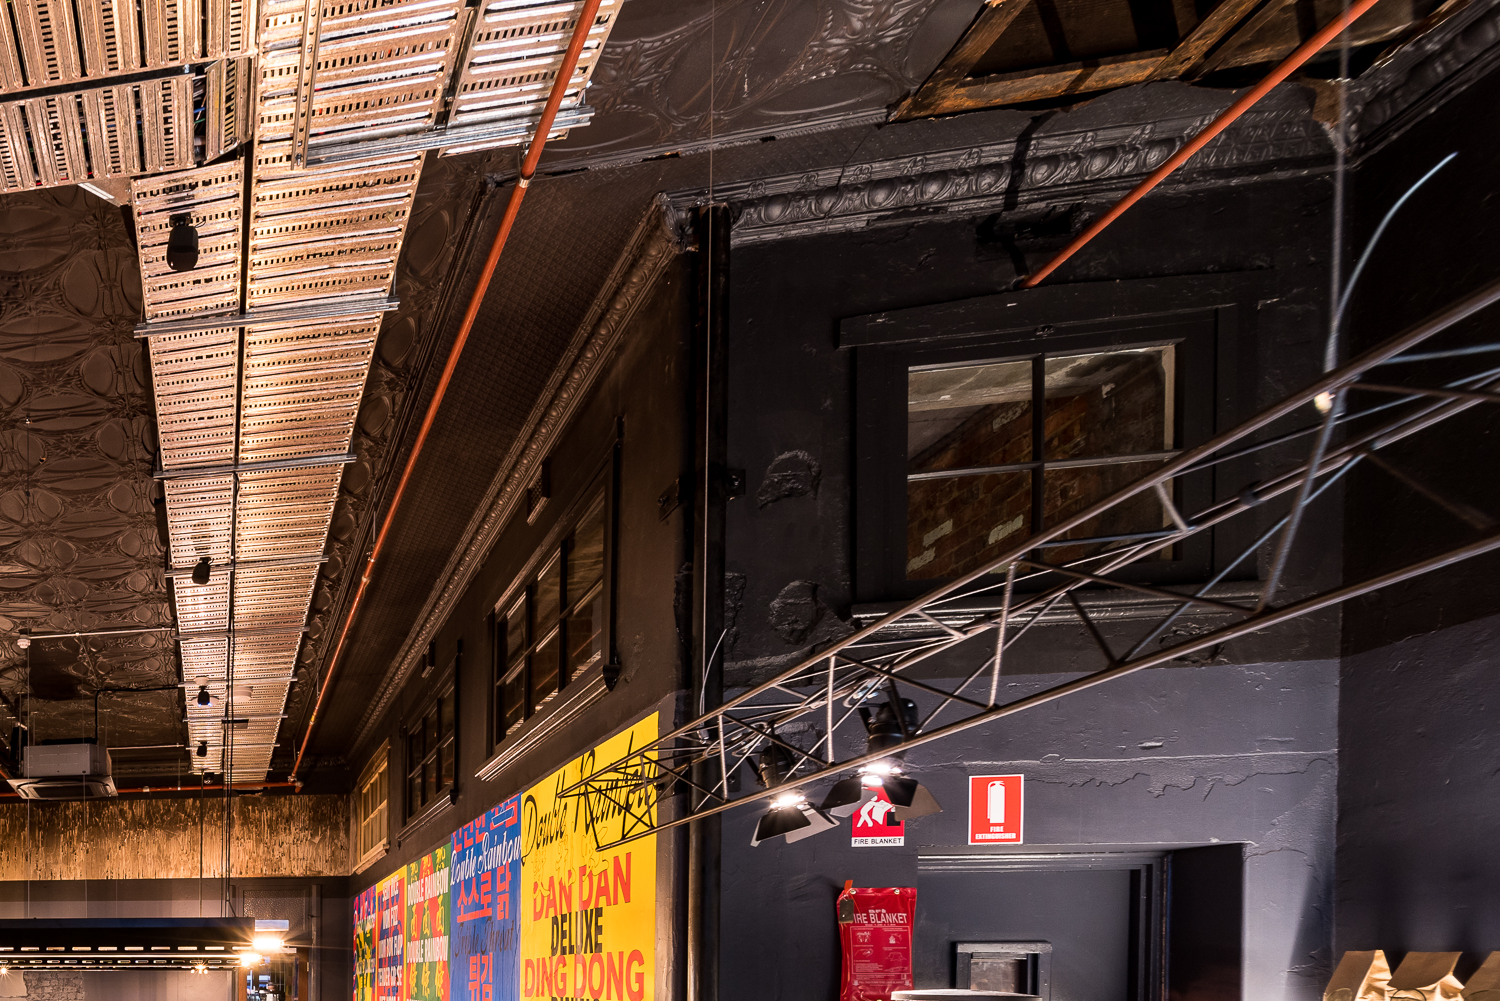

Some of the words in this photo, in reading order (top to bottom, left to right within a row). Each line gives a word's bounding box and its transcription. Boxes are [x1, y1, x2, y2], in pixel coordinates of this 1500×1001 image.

[521, 770, 567, 866] Double
[975, 832, 1016, 840] EXTINGUISHER
[450, 846, 477, 886] Double
[478, 831, 521, 874] Rainbow
[408, 878, 424, 906] DOUBLE
[425, 867, 449, 900] RAINBOW
[457, 871, 492, 923] 소스로
[496, 861, 512, 920] 닭
[533, 870, 571, 921] DAN
[579, 852, 631, 911] DAN
[454, 922, 479, 963] Triple
[480, 916, 515, 955] Threat
[551, 907, 603, 956] DELUXE
[853, 913, 868, 923] IRE
[870, 913, 907, 923] BLANKET
[407, 939, 423, 963] DOUBLE
[425, 935, 449, 962] RAINBOW
[524, 954, 567, 998] DING
